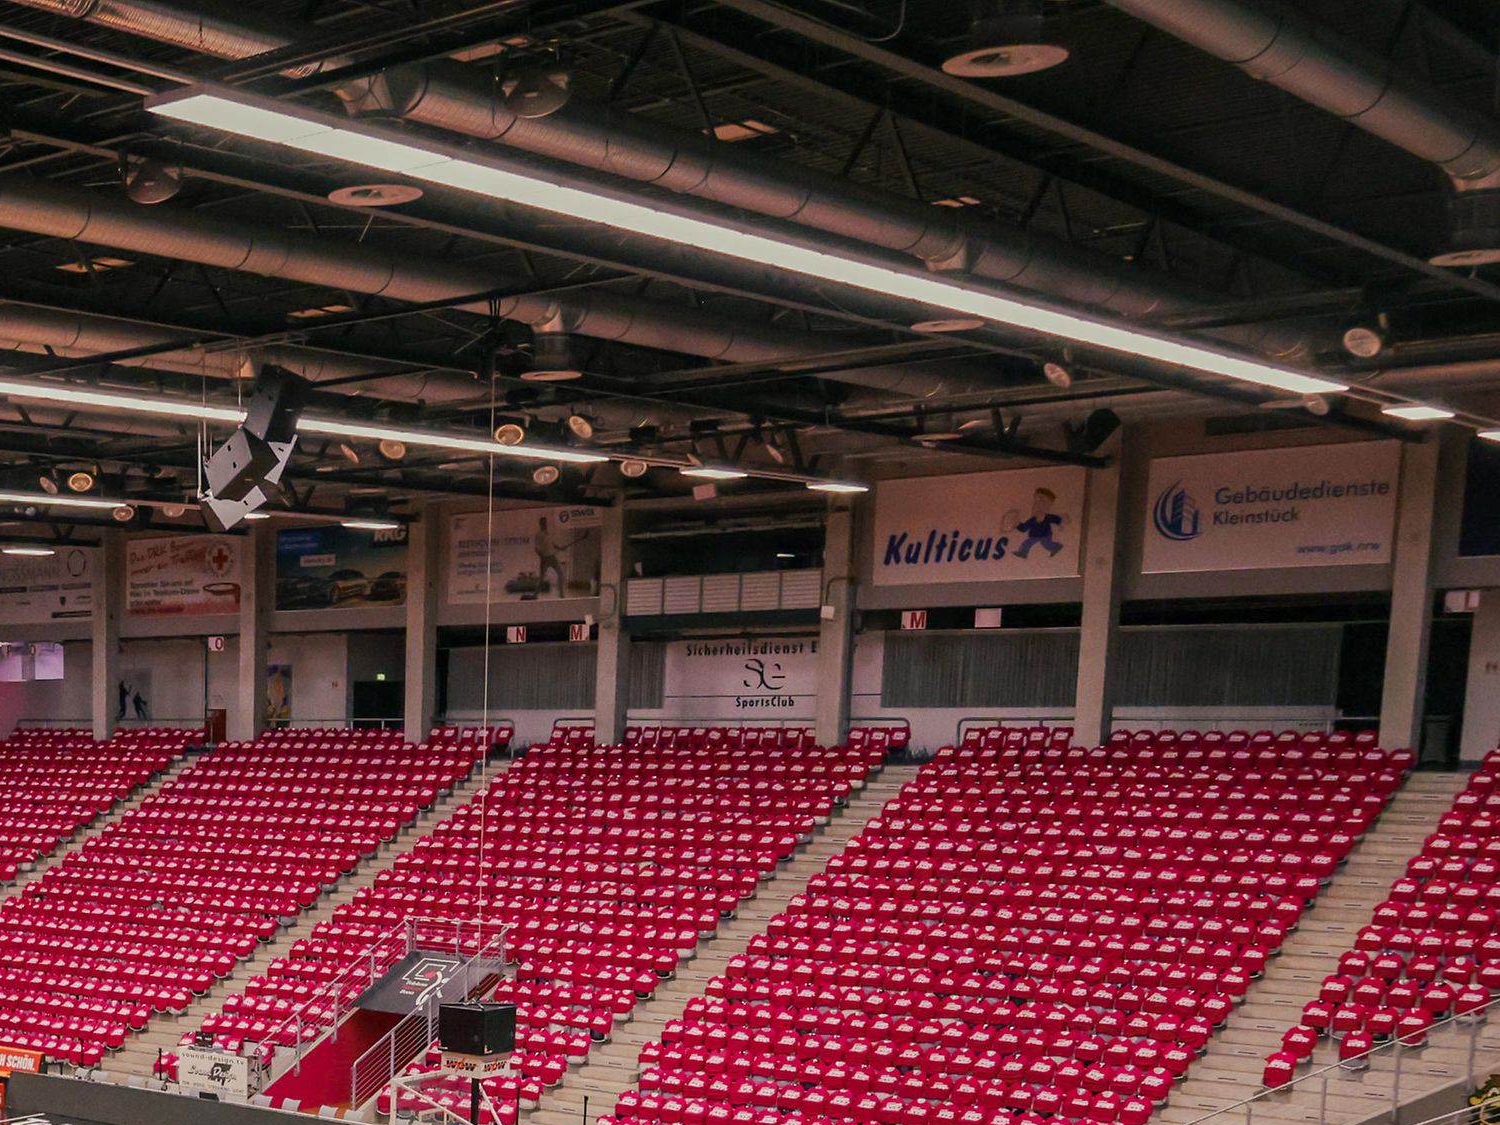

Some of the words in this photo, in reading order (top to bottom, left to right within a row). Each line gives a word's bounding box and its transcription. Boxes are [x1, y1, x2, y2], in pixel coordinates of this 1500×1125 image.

[1214, 479, 1390, 505] Gebäudedienste
[1212, 507, 1300, 526] Kleinstück
[883, 529, 1009, 566] Kulticus
[910, 612, 926, 628] M
[516, 630, 526, 642] N
[570, 627, 583, 640] M
[686, 641, 804, 657] Sicherheitsdienst
[735, 696, 795, 709] SportsClub
[6, 1054, 36, 1071] SCHÖN.
